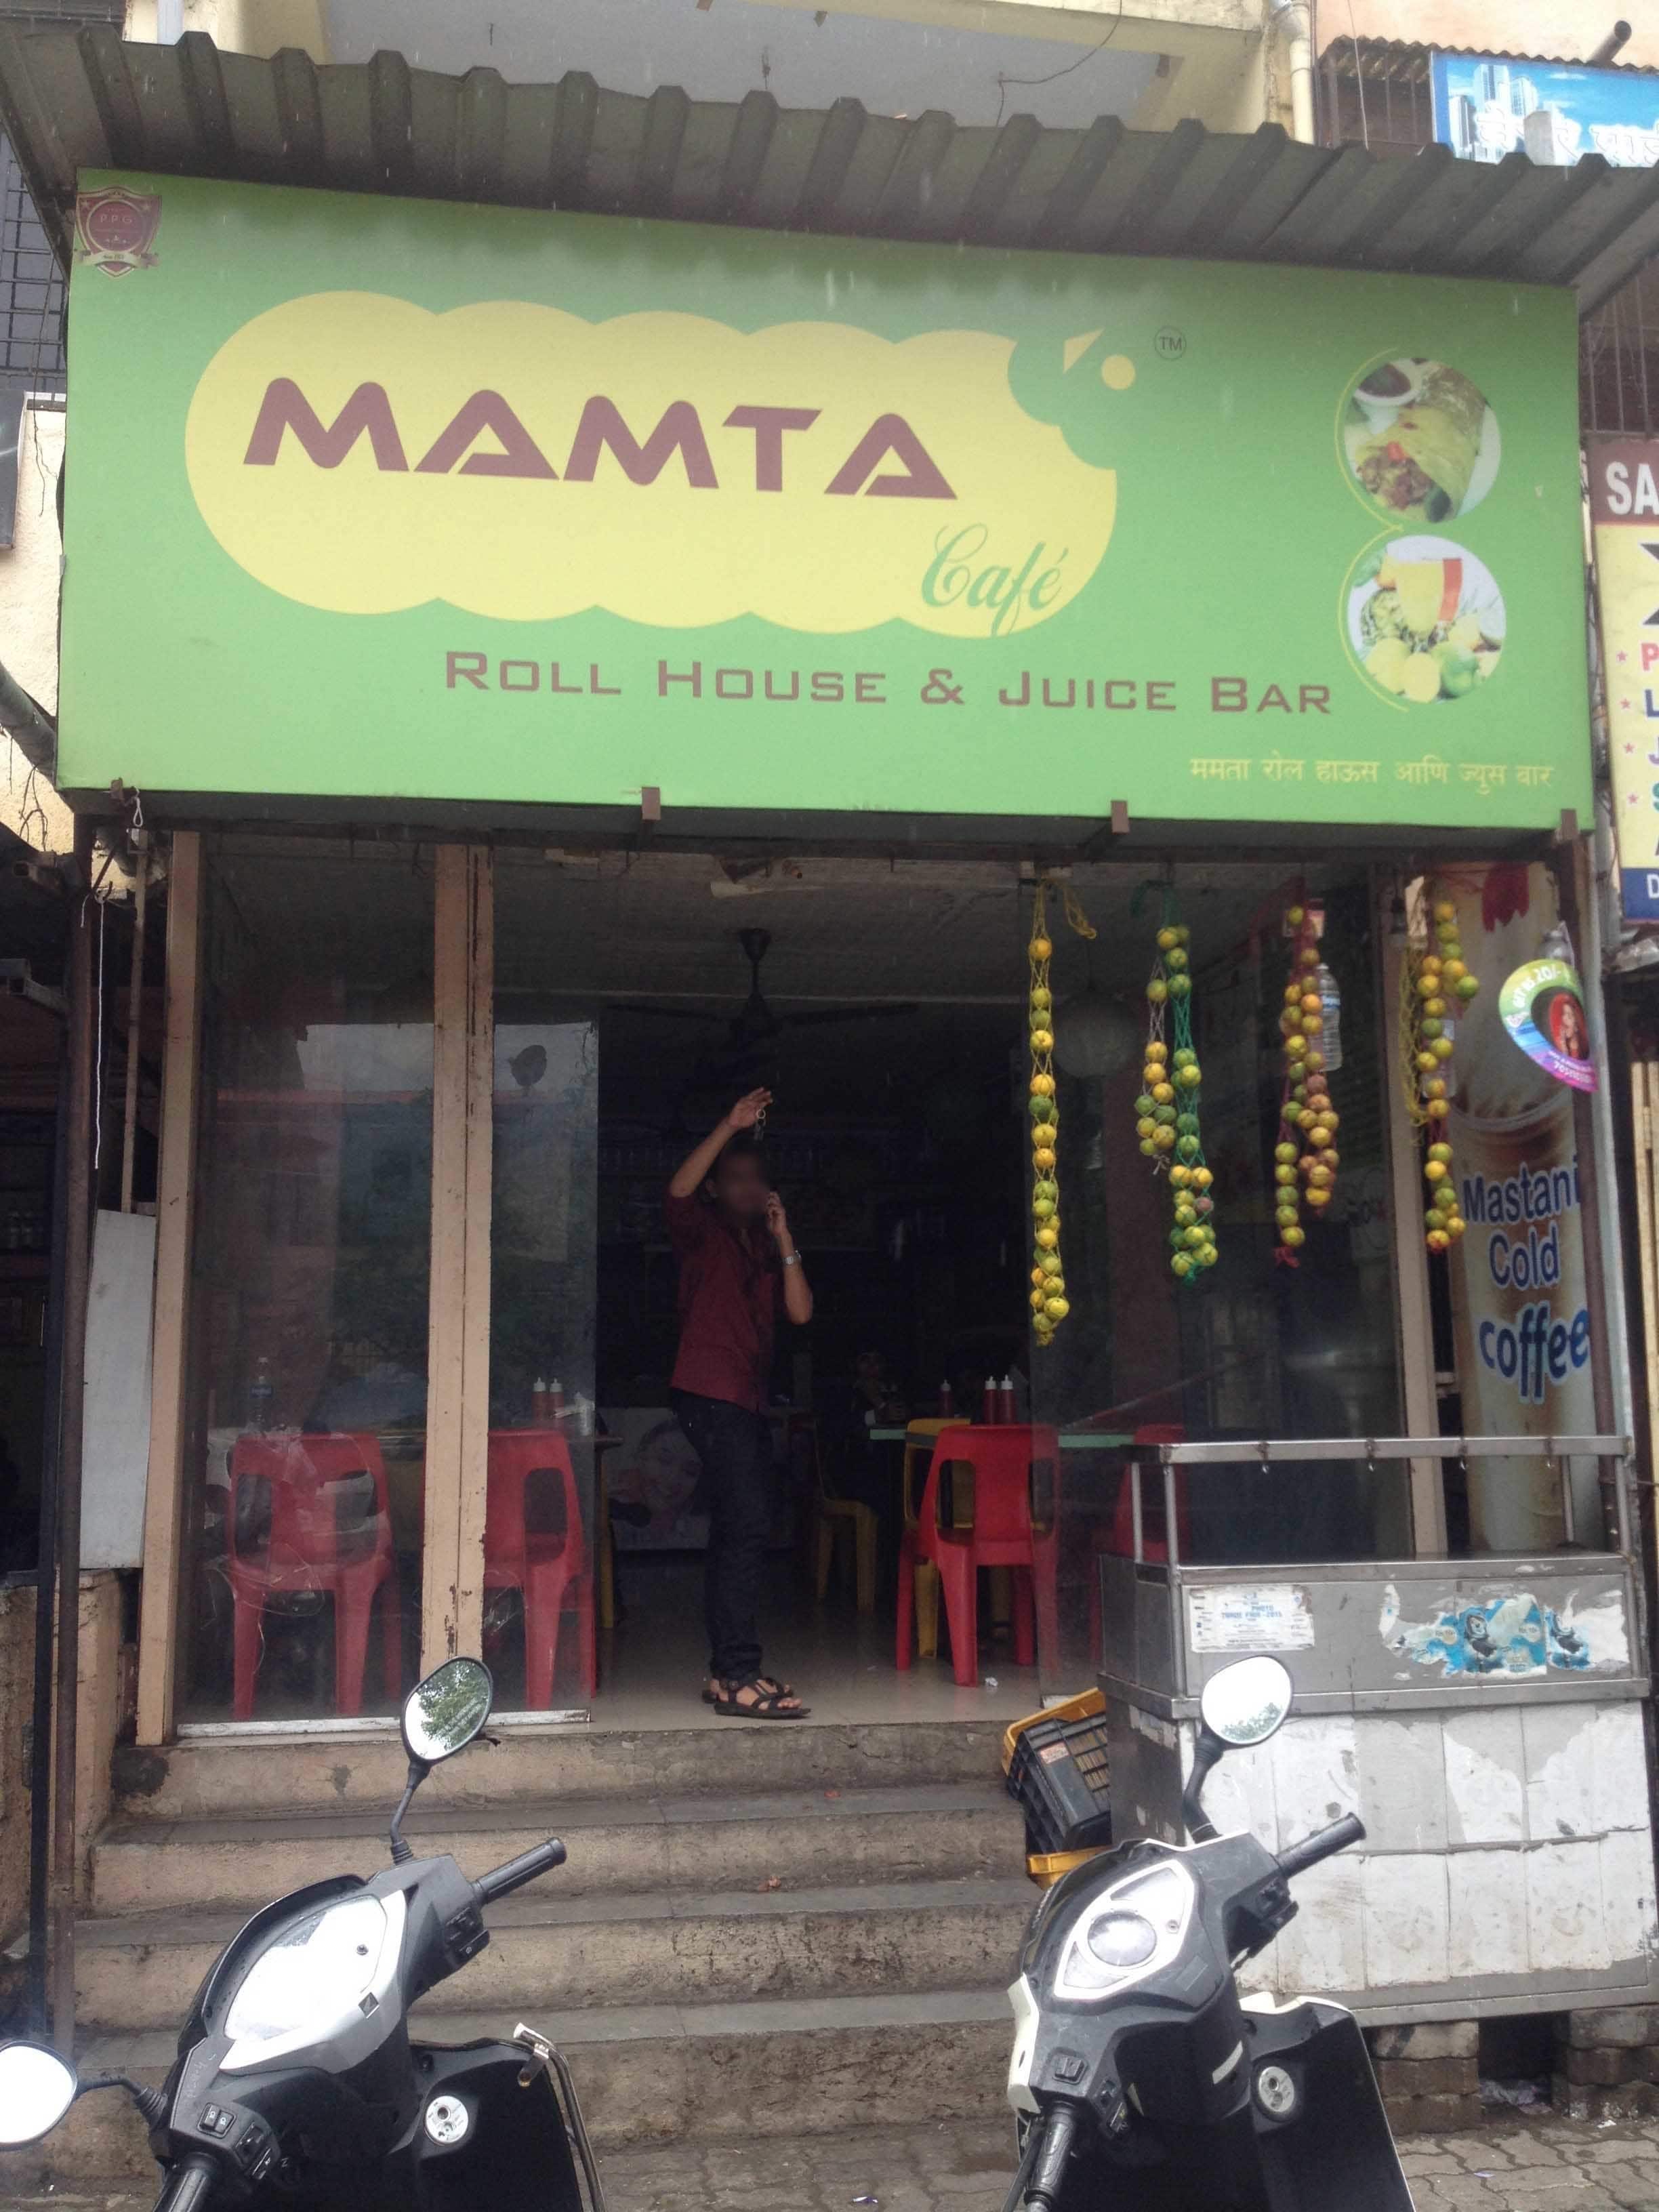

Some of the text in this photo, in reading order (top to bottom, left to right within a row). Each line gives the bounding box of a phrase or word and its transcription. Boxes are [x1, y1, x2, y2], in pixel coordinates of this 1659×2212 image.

[1160, 336, 1183, 351] TM
[243, 377, 958, 500] MAMTA
[920, 523, 1069, 637] Café
[446, 651, 1332, 714] ROLL HOUSE & JUICE BAR
[1189, 758, 1252, 781] ममता
[1261, 748, 1305, 781] रोल
[1395, 753, 1450, 784] आणि
[1463, 1155, 1581, 1222] Mastani
[1490, 1225, 1559, 1287] Cold
